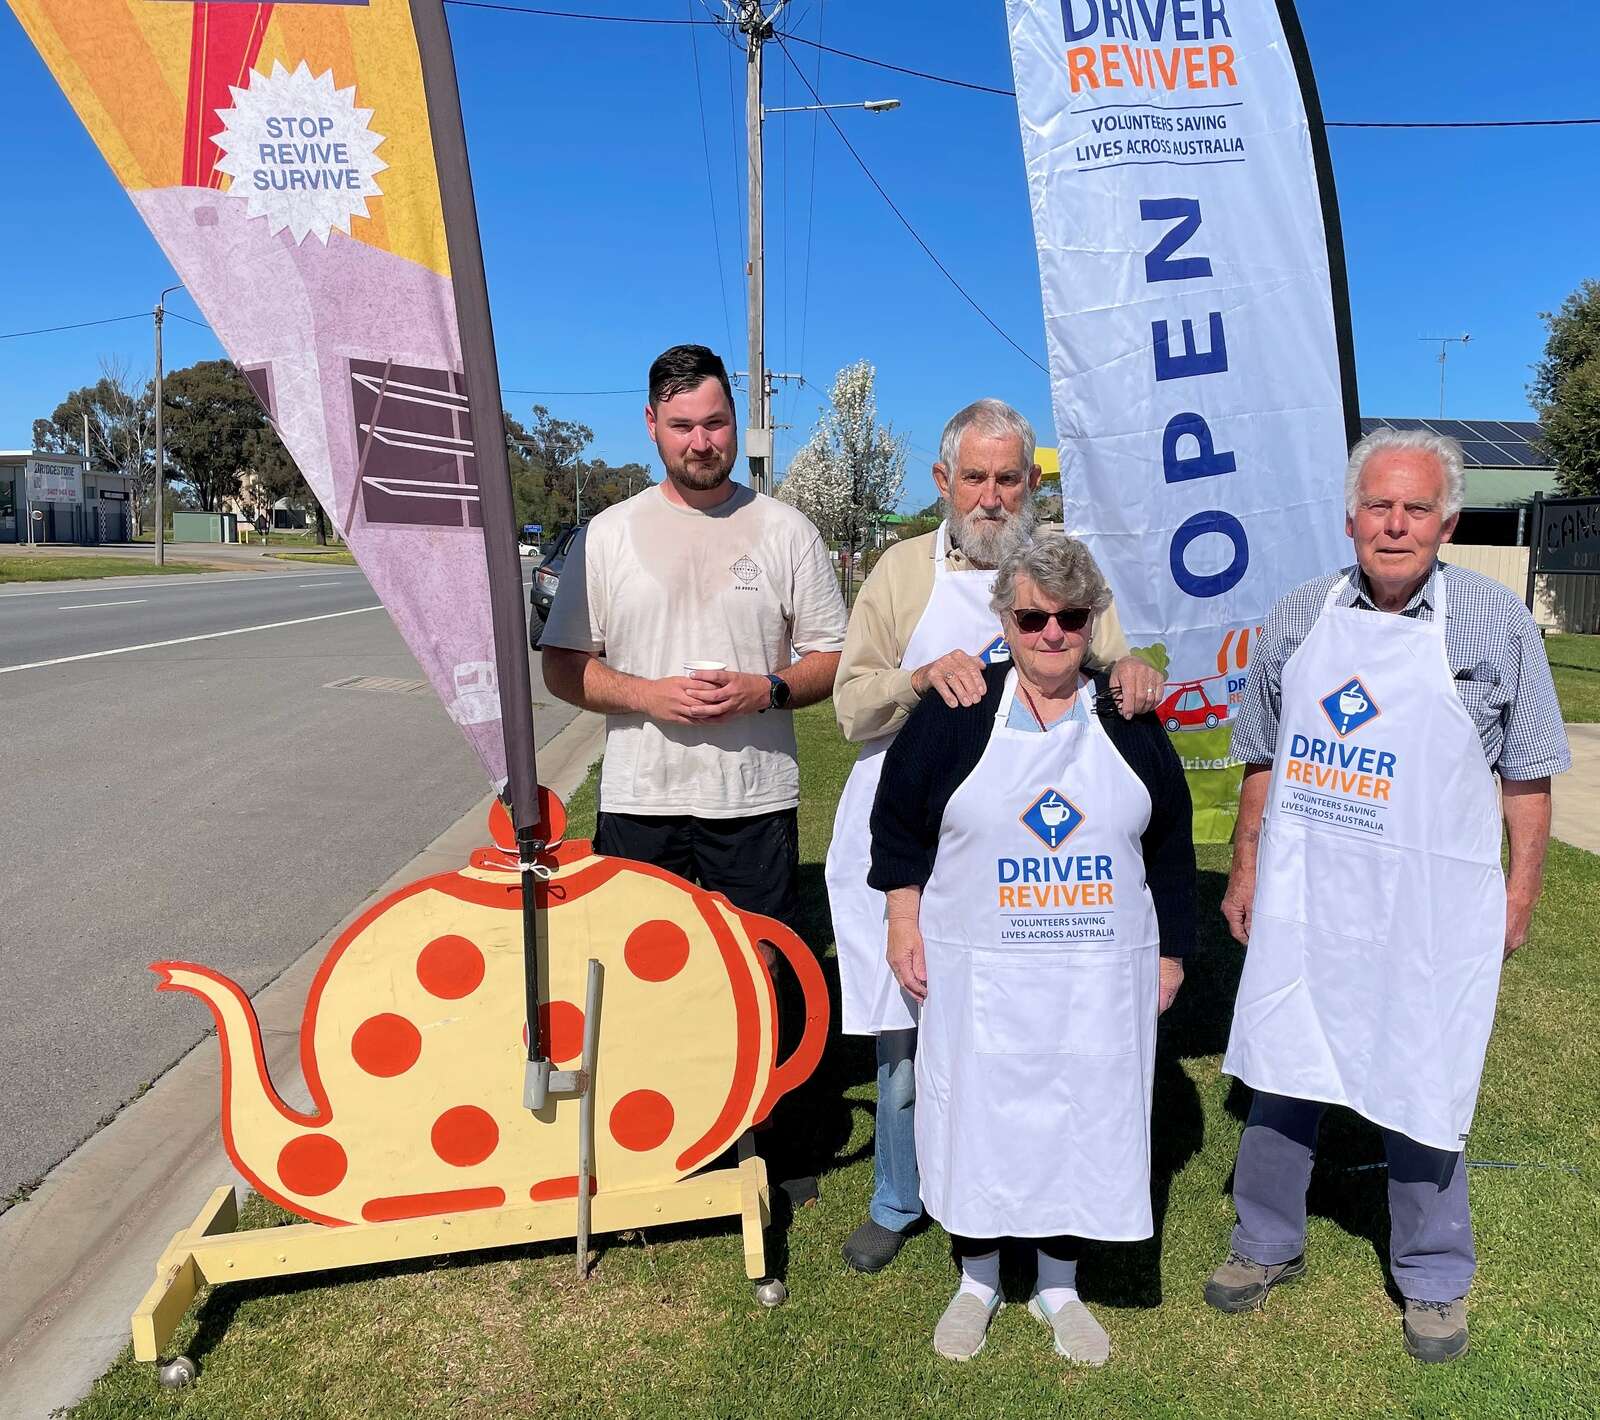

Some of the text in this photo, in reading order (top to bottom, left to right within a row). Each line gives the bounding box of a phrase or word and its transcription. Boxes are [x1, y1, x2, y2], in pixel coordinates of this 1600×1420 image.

[1060, 0, 1232, 42] DRIVER
[1067, 44, 1238, 93] REVIVER
[266, 117, 334, 138] STOP
[1092, 115, 1227, 134] VOLUNTEERS SAVING
[258, 143, 349, 165] REVIVE
[1076, 137, 1245, 161] LIVES ACROSS AUSTRALIA
[253, 169, 361, 191] SURVIVE
[1139, 197, 1249, 598] OPEN
[1290, 734, 1397, 778] DRIVER
[1286, 759, 1392, 801] REVIVER
[1281, 800, 1384, 832] LIVES ACROSS AUSTRALIA
[1293, 791, 1377, 818] VOLUNTEERS SAVING
[998, 855, 1113, 883] DRIVER
[999, 883, 1114, 908] REVIVER
[1001, 928, 1115, 939] LIVES ACROSS AUSTRALIA
[1010, 916, 1106, 928] VOLUNTEERS SAVING
